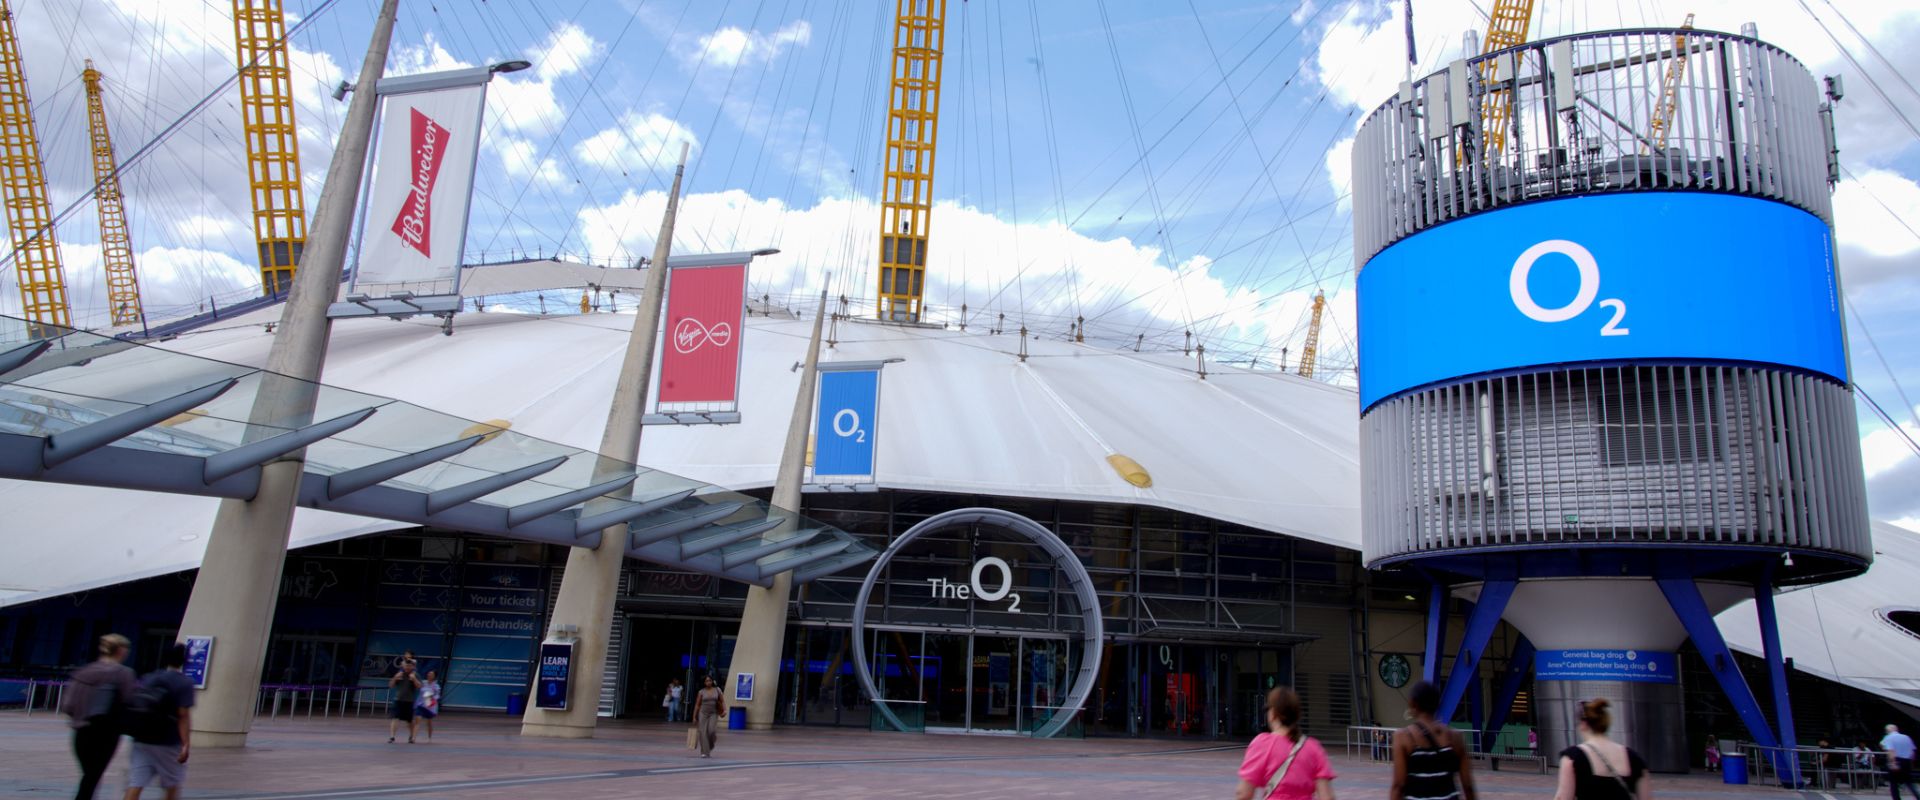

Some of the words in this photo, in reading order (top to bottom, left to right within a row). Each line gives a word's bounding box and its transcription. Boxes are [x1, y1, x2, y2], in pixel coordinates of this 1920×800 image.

[401, 117, 438, 250] Budweiser
[1509, 238, 1630, 337] O2
[678, 324, 702, 347] Virgin
[833, 408, 866, 444] O2
[927, 578, 970, 600] The
[970, 556, 1021, 614] O2
[469, 593, 496, 606] Your
[499, 594, 537, 607] tickets
[462, 617, 536, 631] Merchandise
[543, 655, 569, 666] LEARN
[1562, 651, 1590, 659] General
[1591, 651, 1606, 660] bag
[1606, 651, 1625, 660] drop
[1566, 661, 1612, 669] Cardmember
[1613, 662, 1629, 671] bag
[1629, 662, 1647, 671] drop
